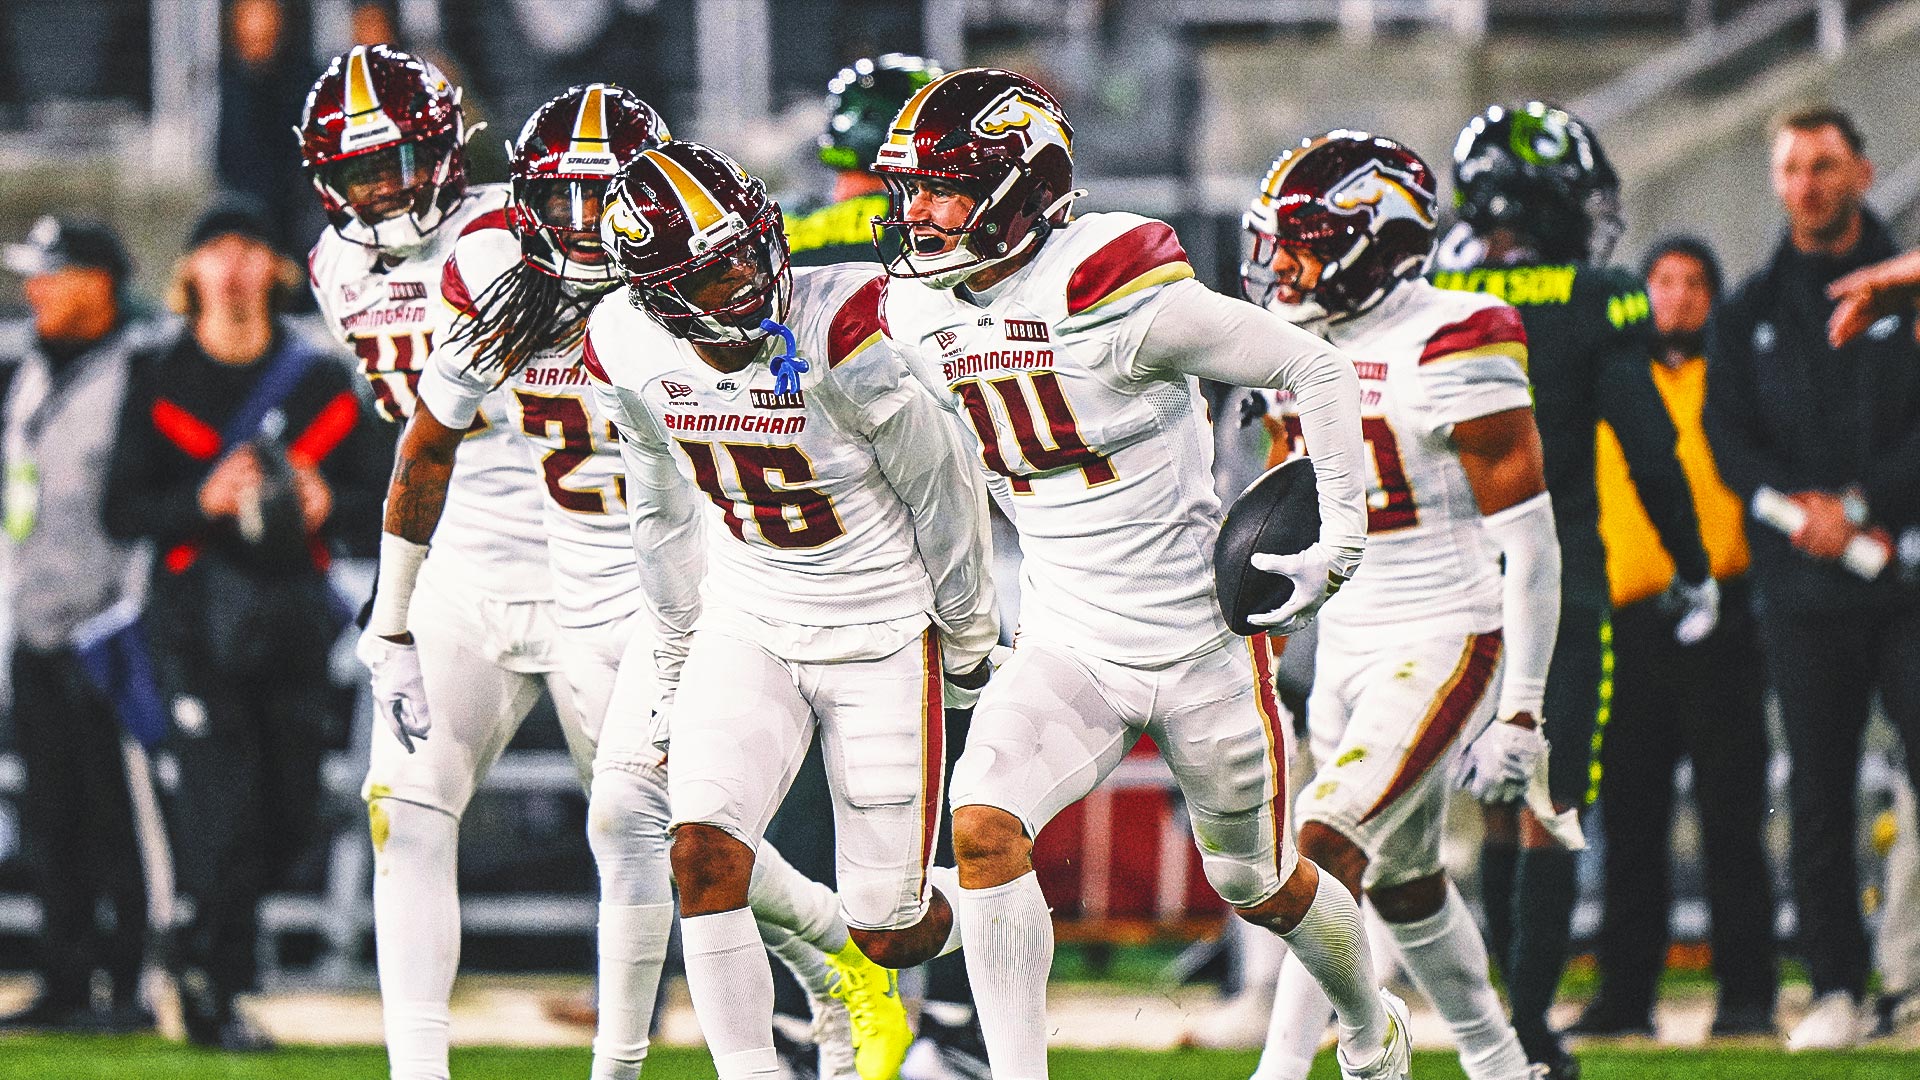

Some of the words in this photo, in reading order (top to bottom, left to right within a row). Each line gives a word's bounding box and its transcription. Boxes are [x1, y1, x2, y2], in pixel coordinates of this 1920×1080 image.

[567, 157, 611, 165] STALLIONS
[977, 317, 994, 327] UFL
[1005, 322, 1048, 338] NOBULL
[943, 349, 1054, 381] BIRMINGHAM
[716, 382, 738, 391] UFL
[751, 392, 803, 406] NOBULL
[664, 413, 807, 434] BIRMINGHAM
[948, 371, 1121, 496] 14
[512, 388, 627, 515] 2
[671, 435, 848, 549] 16
